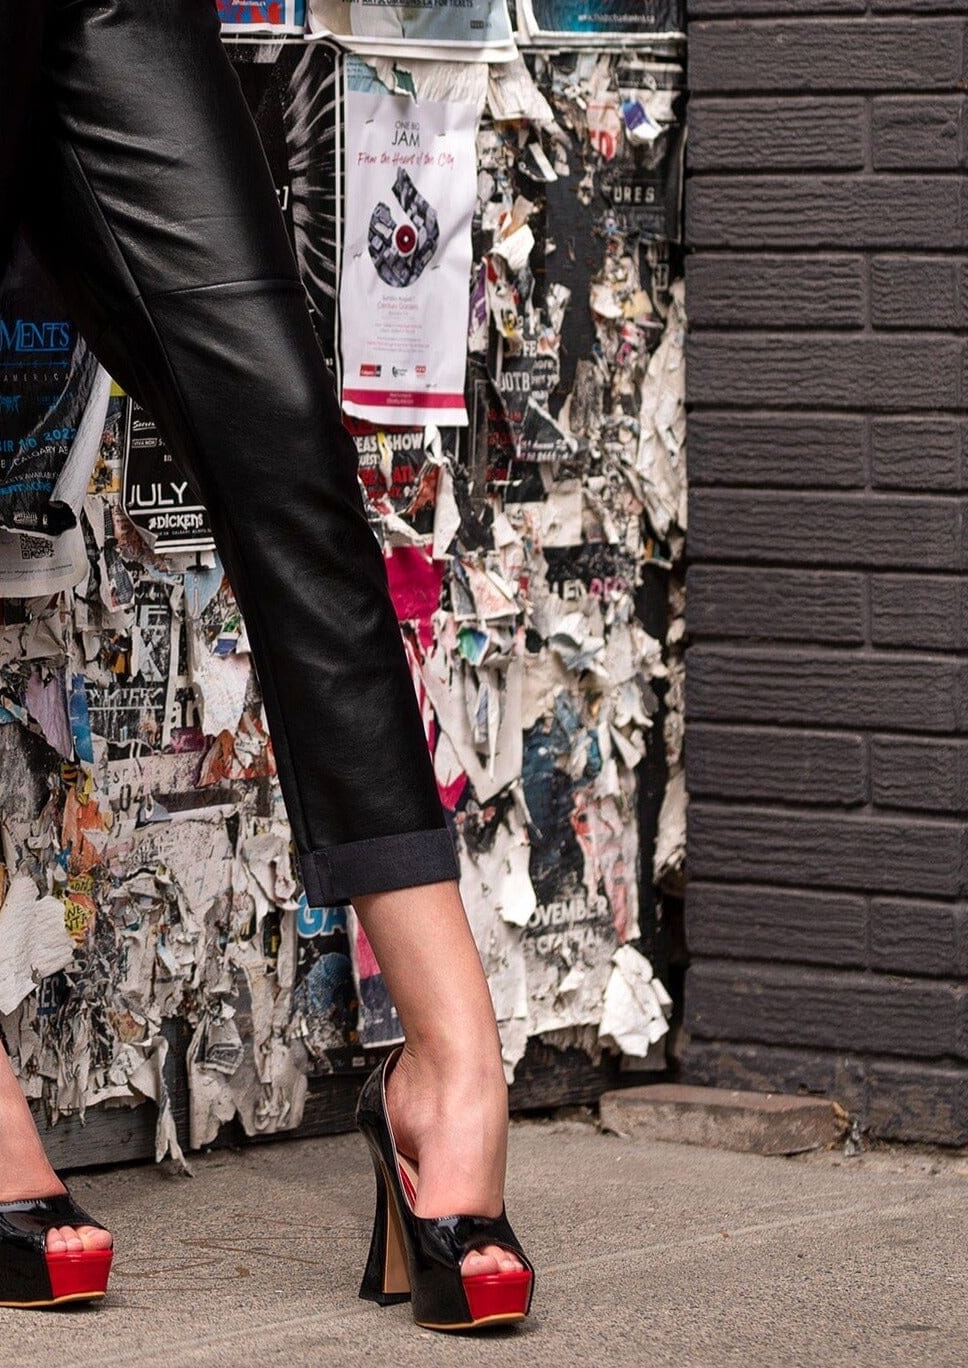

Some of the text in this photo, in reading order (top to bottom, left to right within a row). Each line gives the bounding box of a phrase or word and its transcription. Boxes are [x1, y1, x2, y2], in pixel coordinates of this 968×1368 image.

[392, 132, 420, 147] JAM
[389, 433, 423, 451] SHOW
[129, 482, 188, 507] JULY
